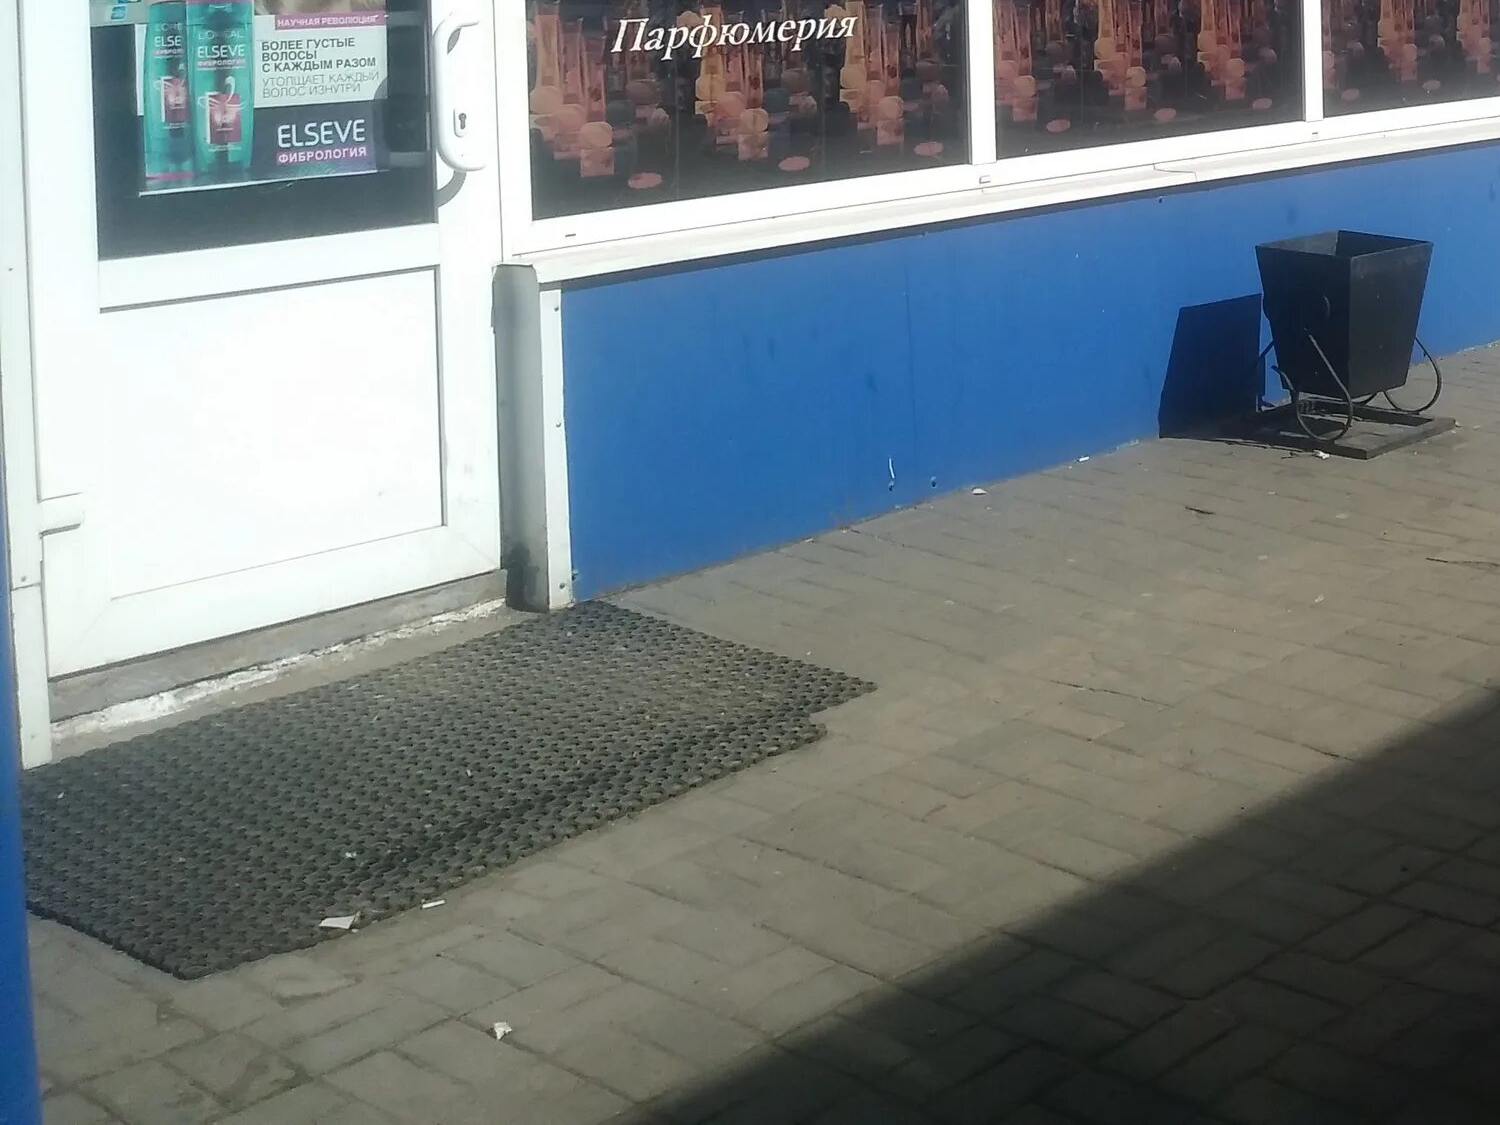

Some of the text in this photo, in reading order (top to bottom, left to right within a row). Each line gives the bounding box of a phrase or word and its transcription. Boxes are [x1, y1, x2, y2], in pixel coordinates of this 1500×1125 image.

[277, 15, 376, 27] НАУЧНАЯ РЕВОЛЮЦИЯ
[154, 35, 182, 47] ELSE
[262, 37, 355, 51] БОЛЕЕ ГУСТЫЕ
[610, 14, 858, 61] Парфюмерия
[197, 44, 245, 58] ELSEVE
[262, 50, 317, 62] ВОЛОСЫ
[262, 57, 376, 72] С КАЖДЫМ РАЗОМ
[263, 83, 360, 98] ВОЛОС ИЗНУТРИ
[277, 119, 366, 148] ELSEVE
[279, 146, 367, 164] ФИБРОЛОГИЯ
